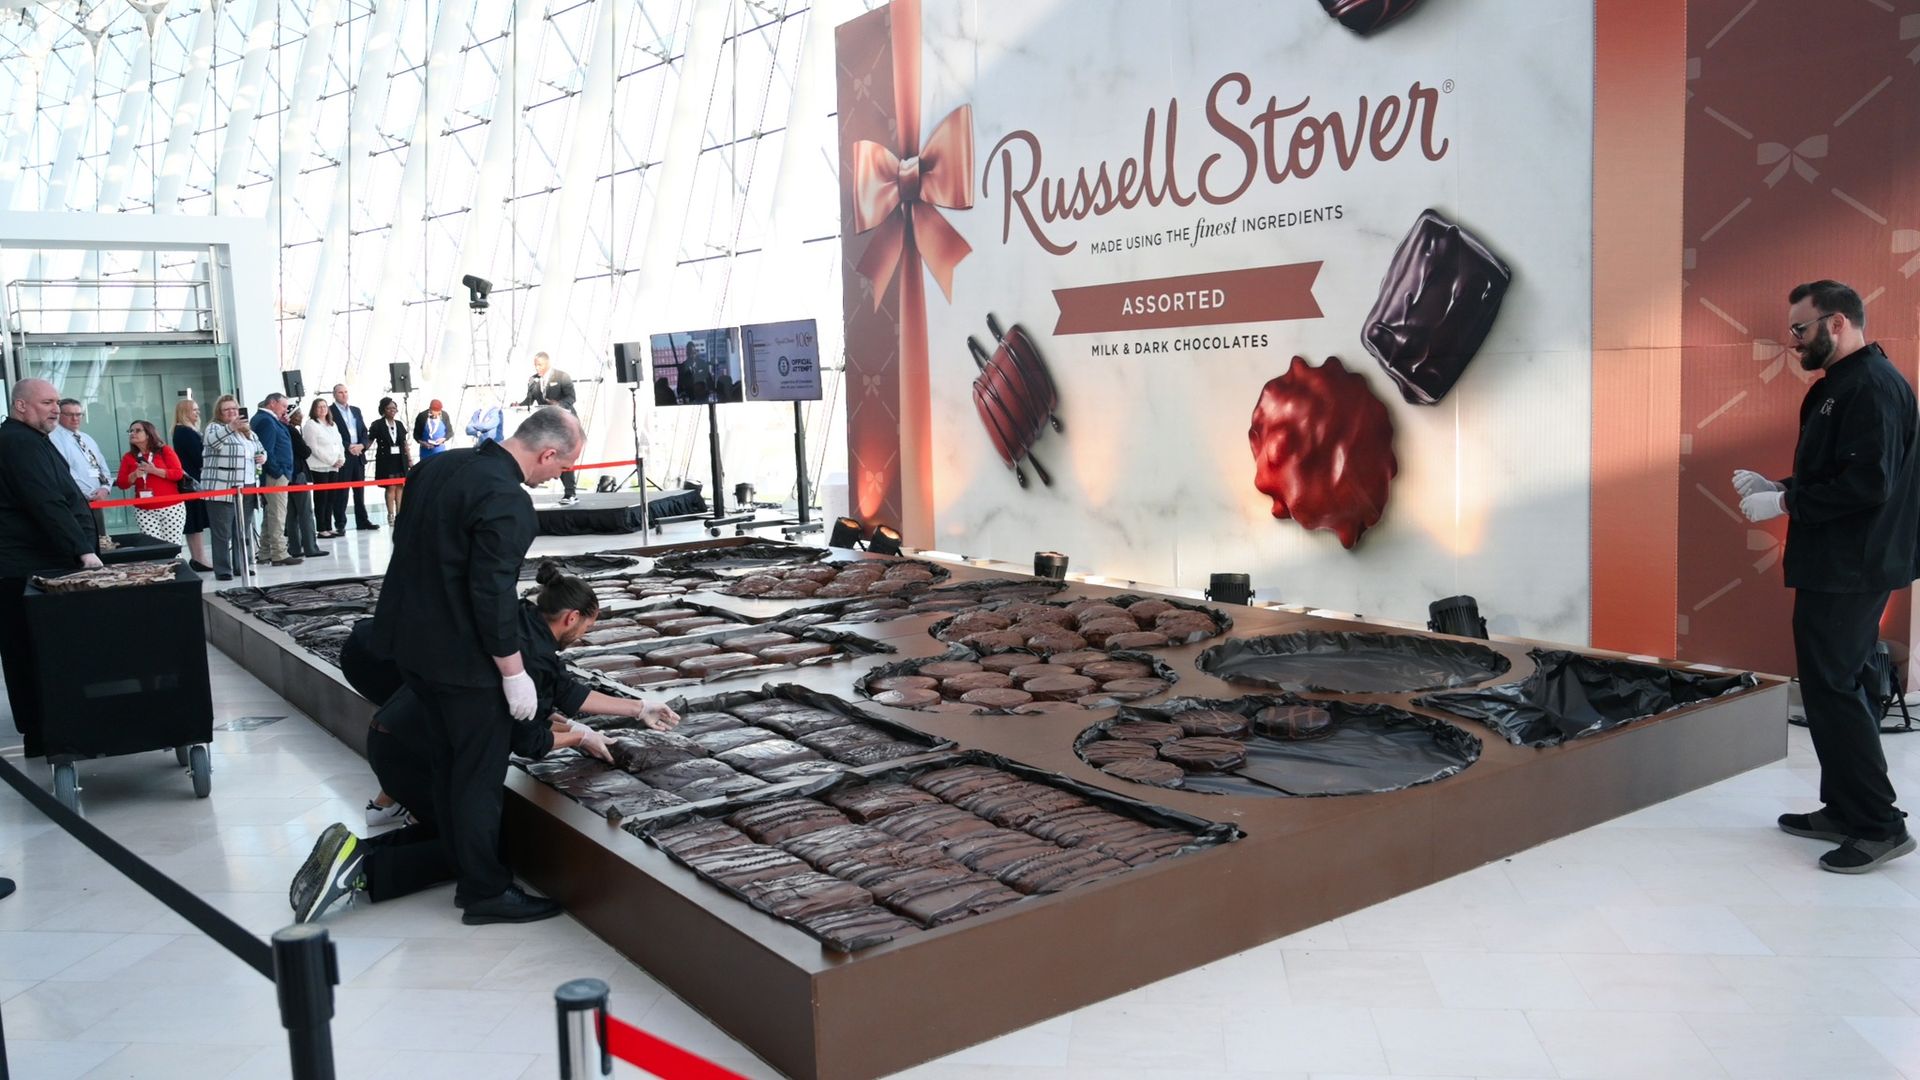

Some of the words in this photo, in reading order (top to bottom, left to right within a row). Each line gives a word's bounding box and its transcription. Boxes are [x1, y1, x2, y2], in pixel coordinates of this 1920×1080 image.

[982, 97, 1197, 256] Russell
[1091, 238, 1123, 255] MADE
[1126, 232, 1162, 250] USING
[1166, 227, 1190, 243] THE
[1190, 216, 1237, 247] finest
[1242, 204, 1344, 233] INGREDIENTS
[1121, 288, 1226, 316] ASSORTED
[1091, 343, 1119, 357] MILK
[1123, 343, 1130, 355] &
[1135, 340, 1169, 354] DARK
[1173, 334, 1269, 352] CHOCOLATES
[791, 358, 813, 366] OFFICIAL
[792, 365, 813, 373] ATTEMPT
